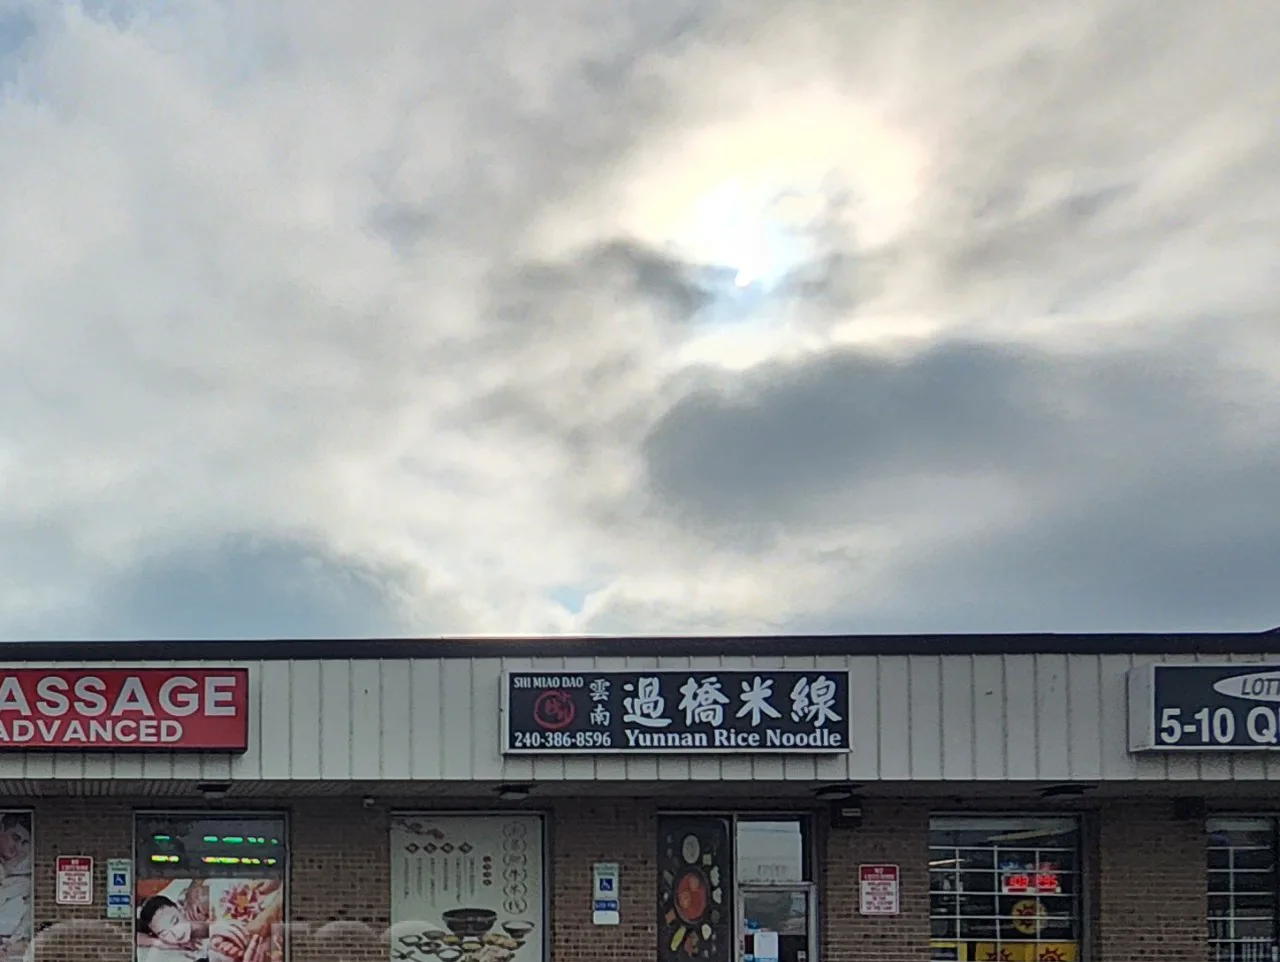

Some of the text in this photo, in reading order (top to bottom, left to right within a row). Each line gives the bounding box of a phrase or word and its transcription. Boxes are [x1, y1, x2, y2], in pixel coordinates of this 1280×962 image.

[514, 677, 584, 688] SHI MIAO DAO
[589, 679, 611, 726] 雲南
[623, 676, 843, 728] 過橋米線
[625, 729, 842, 747] Yunnan Rice Noodle
[1160, 706, 1280, 744] 5-10 Q
